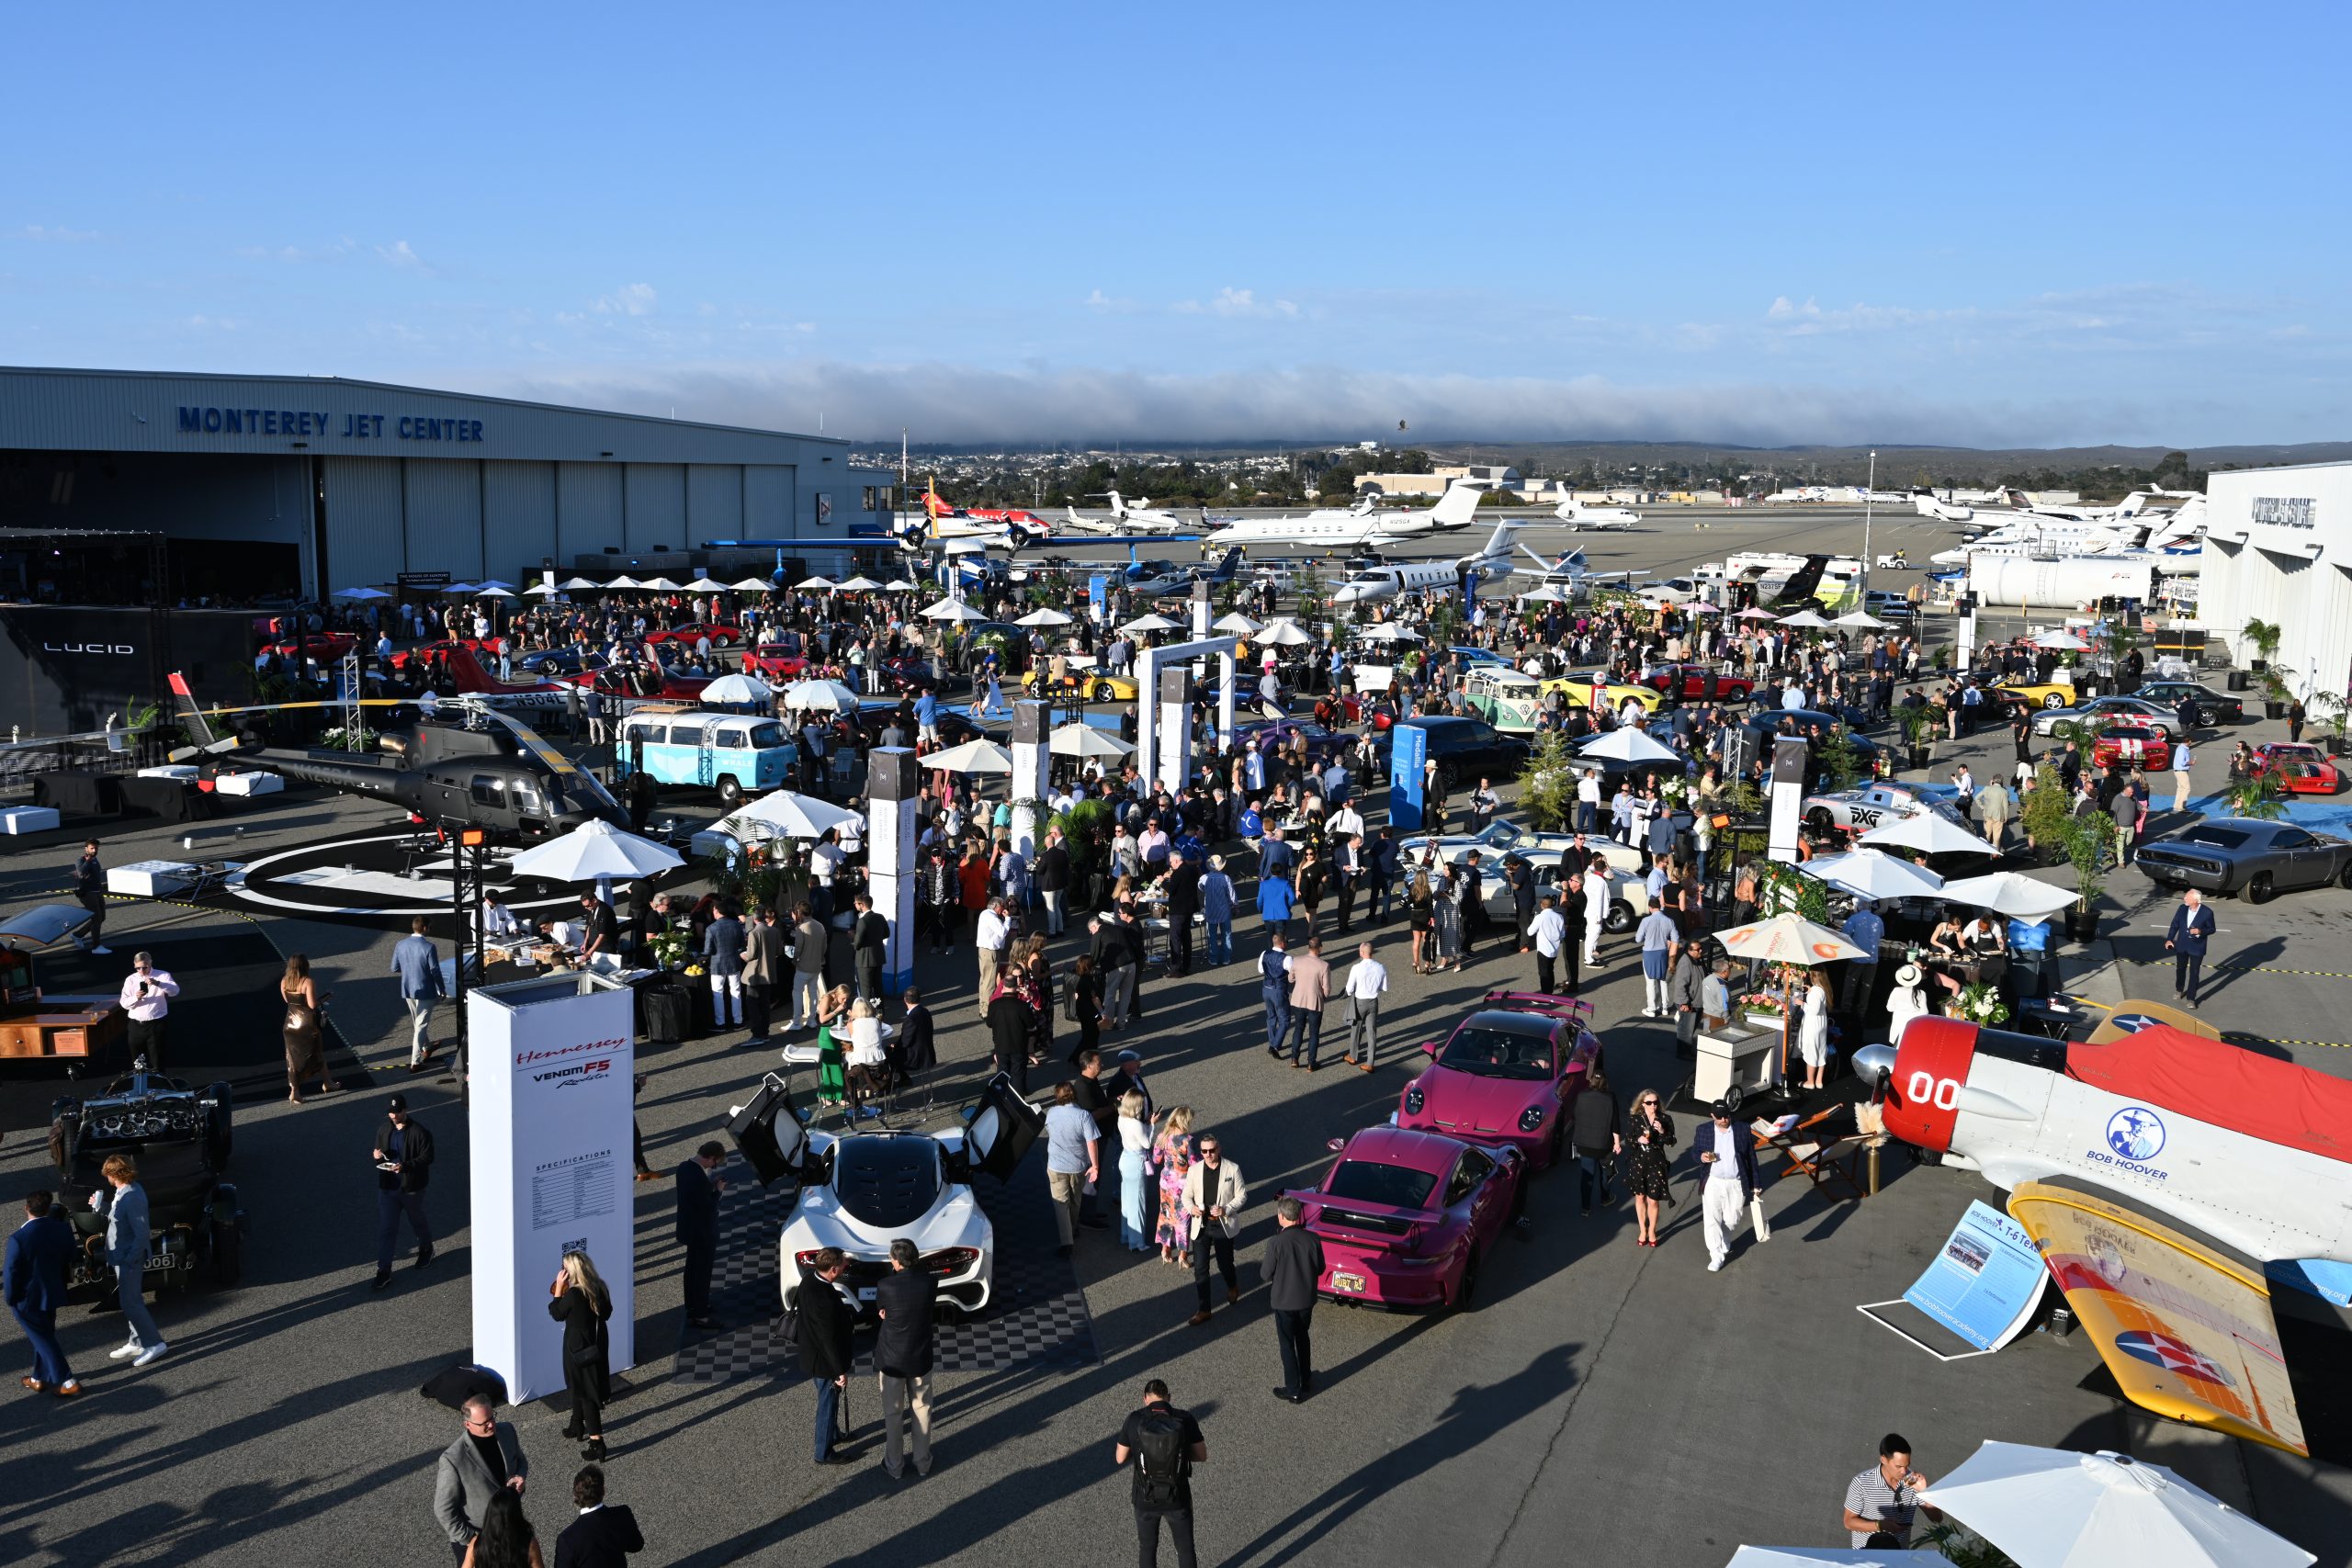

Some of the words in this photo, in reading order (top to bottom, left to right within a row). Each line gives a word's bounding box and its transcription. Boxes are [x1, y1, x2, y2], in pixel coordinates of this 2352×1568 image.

[177, 406, 328, 435] MONTEREY
[341, 413, 384, 438] JET
[398, 416, 483, 442] CENTER
[44, 642, 133, 654] LUCID
[514, 693, 567, 707] N504L
[1413, 735, 1422, 769] Medallia
[1849, 807, 1883, 828] PXG
[1764, 931, 1782, 958] CHANDON
[515, 1038, 628, 1065] Hennessey
[533, 1066, 583, 1082] VENOM
[583, 1059, 612, 1074] F5
[1907, 1071, 1961, 1111] 00
[536, 1149, 611, 1172] SPECIFICATIONS
[2086, 1151, 2113, 1164] BOB
[2115, 1159, 2168, 1180] HOOVER
[1970, 1210, 1981, 1219] BOB
[1980, 1215, 1999, 1228] HOOVER
[2005, 1226, 2020, 1241] T-6
[1909, 1290, 1990, 1346] www.bobhooveracademy.org
